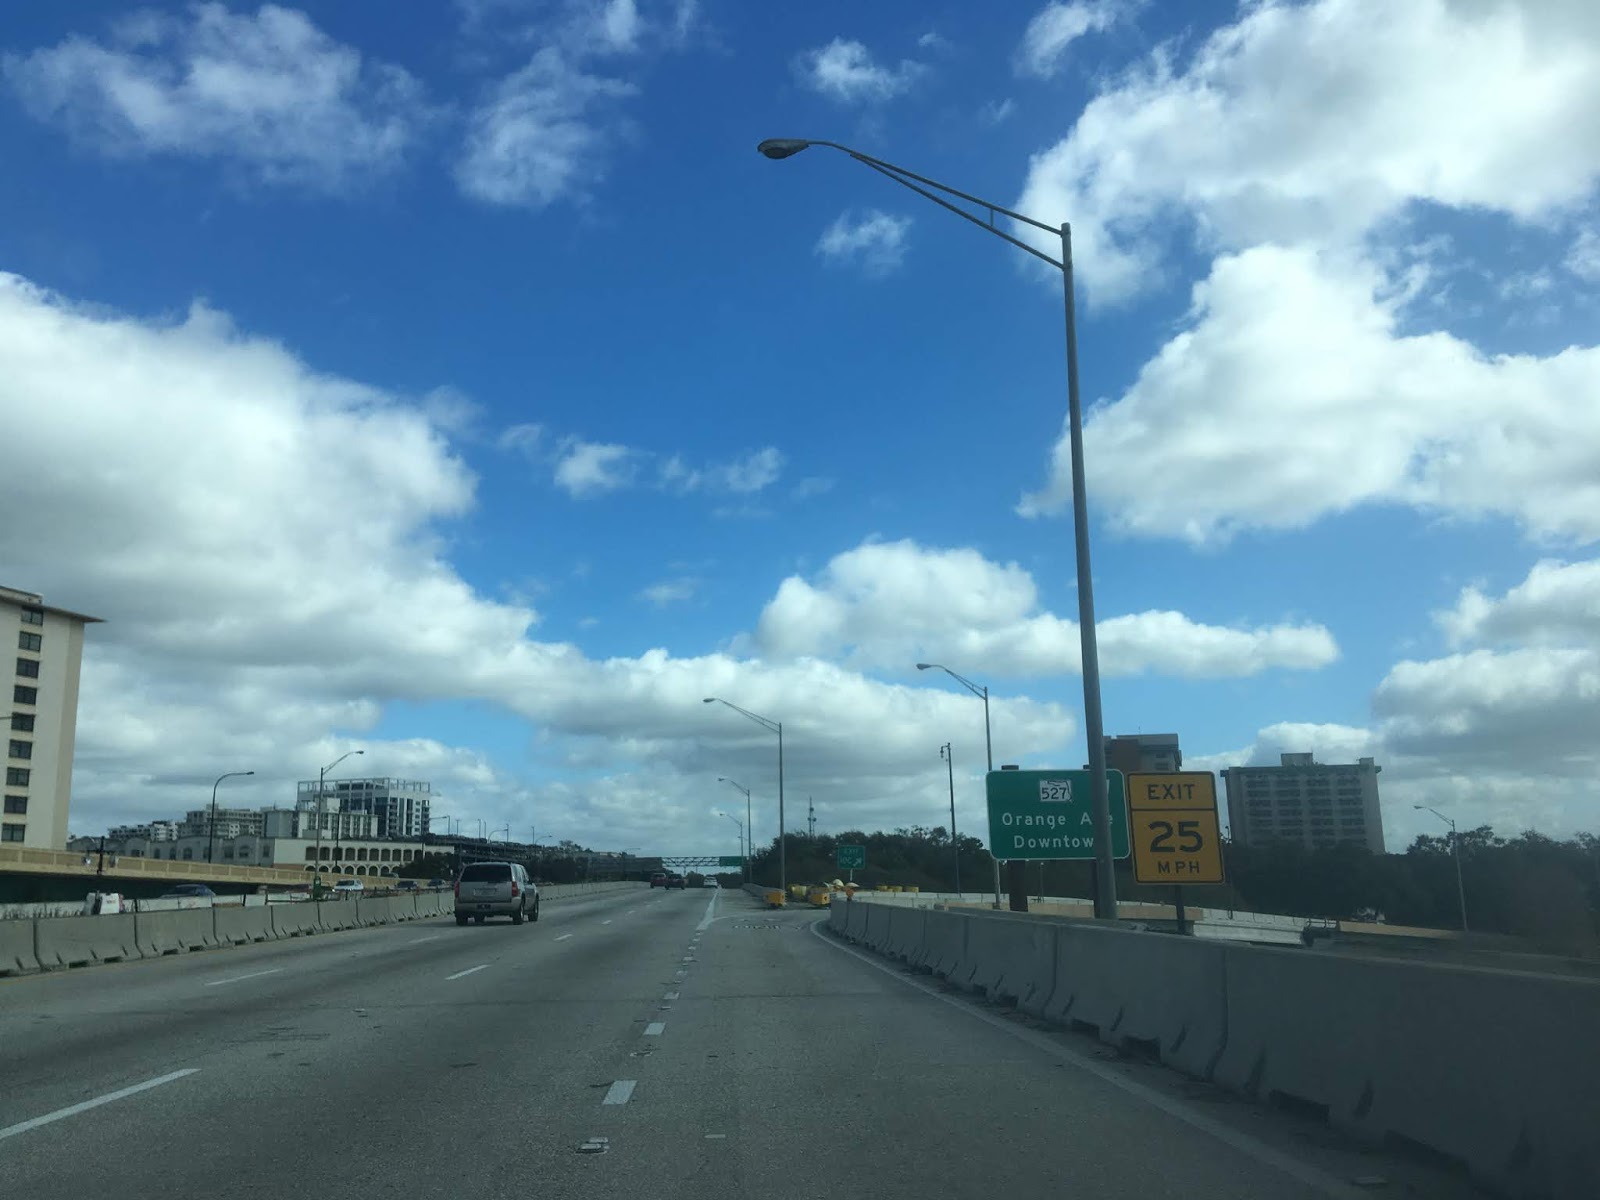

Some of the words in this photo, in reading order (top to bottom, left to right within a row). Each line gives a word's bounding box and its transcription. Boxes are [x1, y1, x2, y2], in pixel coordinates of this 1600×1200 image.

[1041, 787, 1067, 800] 527
[1147, 784, 1195, 800] EXIT
[1001, 812, 1067, 829] Orange
[1080, 812, 1113, 825] Ae
[1014, 835, 1094, 848] Downtow
[1149, 821, 1203, 853] 25
[1157, 861, 1200, 874] MPH
